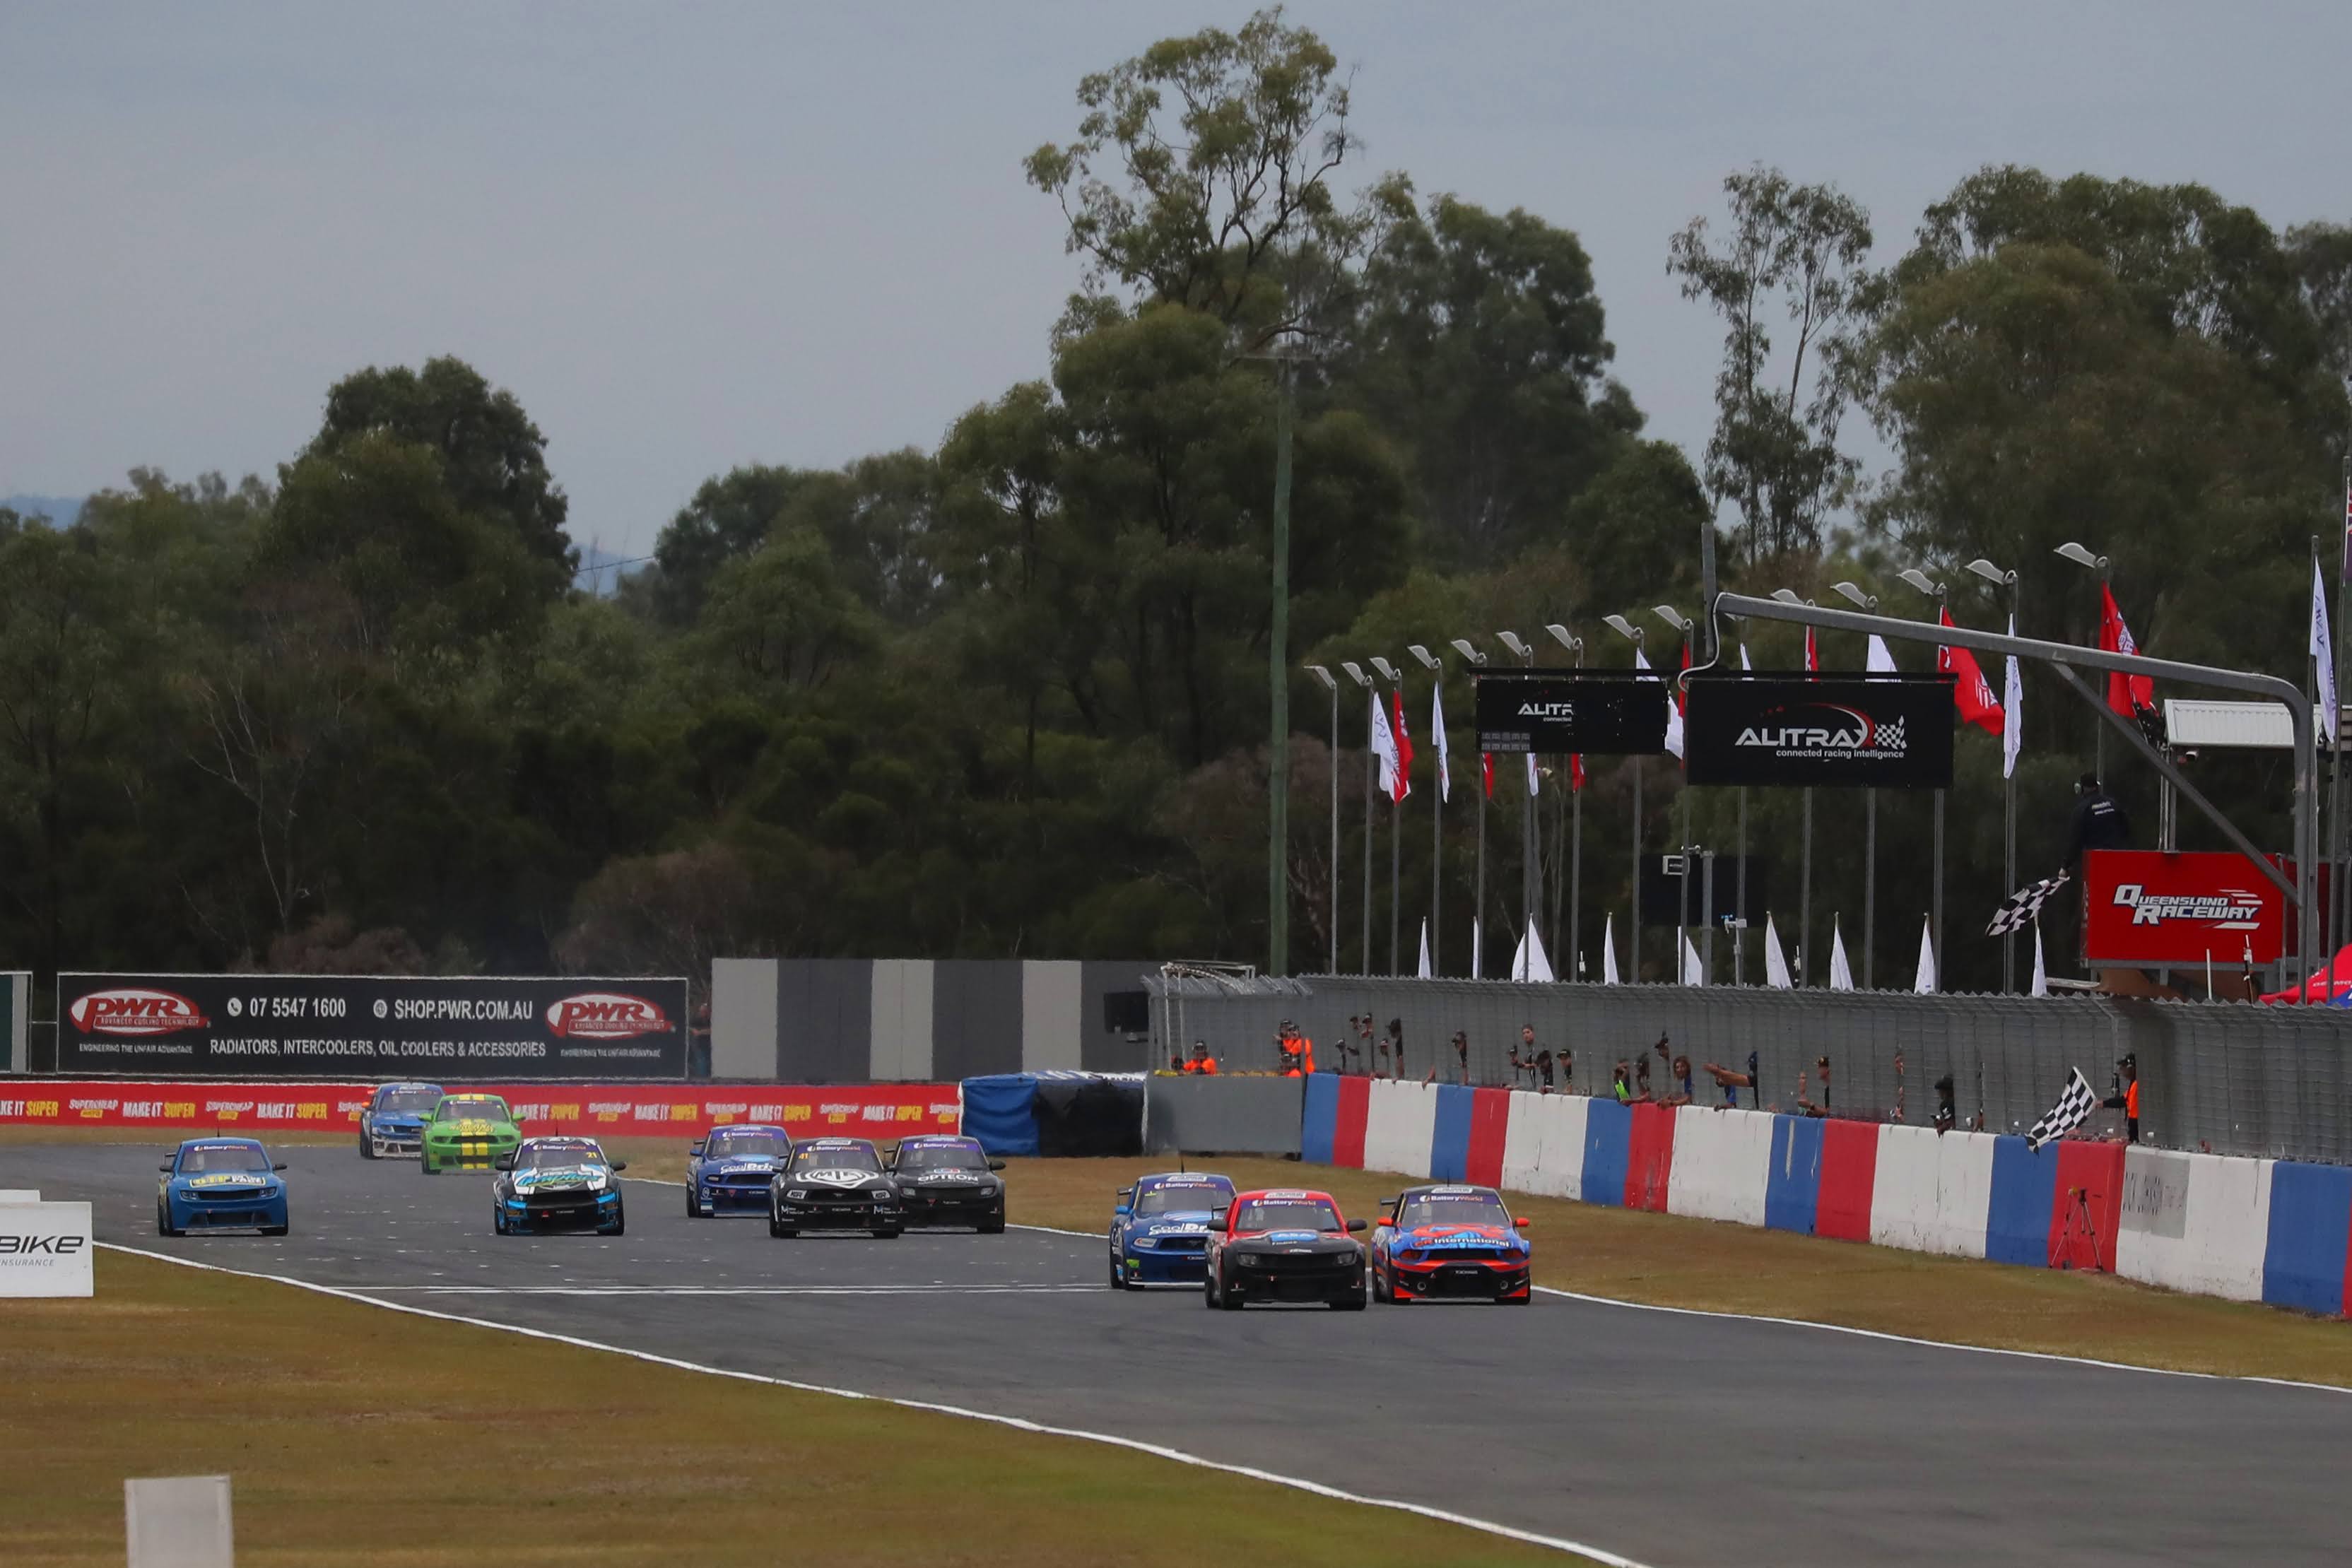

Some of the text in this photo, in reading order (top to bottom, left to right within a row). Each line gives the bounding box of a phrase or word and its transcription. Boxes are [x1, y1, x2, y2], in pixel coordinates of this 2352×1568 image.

[1734, 727, 1871, 748] ALITRAX
[1776, 749, 1822, 758] connected
[1824, 749, 1852, 760] racing
[2113, 885, 2228, 907] QUEENSLAND
[2132, 904, 2258, 924] RACEWAY
[81, 998, 182, 1025] PWR
[249, 998, 346, 1018] 07 5547 1600
[394, 999, 533, 1020] SHOP.PWR.COM.AU
[558, 1002, 646, 1027] PWR
[78, 1043, 119, 1052] ENGINEERING
[122, 1044, 133, 1053] THE
[210, 1039, 546, 1056] RADIATORS, INTERCOOLERS, OIL COOLERS & ACCESSORIES
[0, 1100, 59, 1116] KE IT SUPER
[123, 1102, 196, 1118] MAKE IT SUPER
[257, 1102, 283, 1119] MAKE
[284, 1104, 295, 1119] IT
[296, 1103, 328, 1119] SUPER
[917, 1174, 979, 1182] OPTEON
[1434, 1237, 1510, 1248] International
[0, 1258, 54, 1267] NSURANCE
